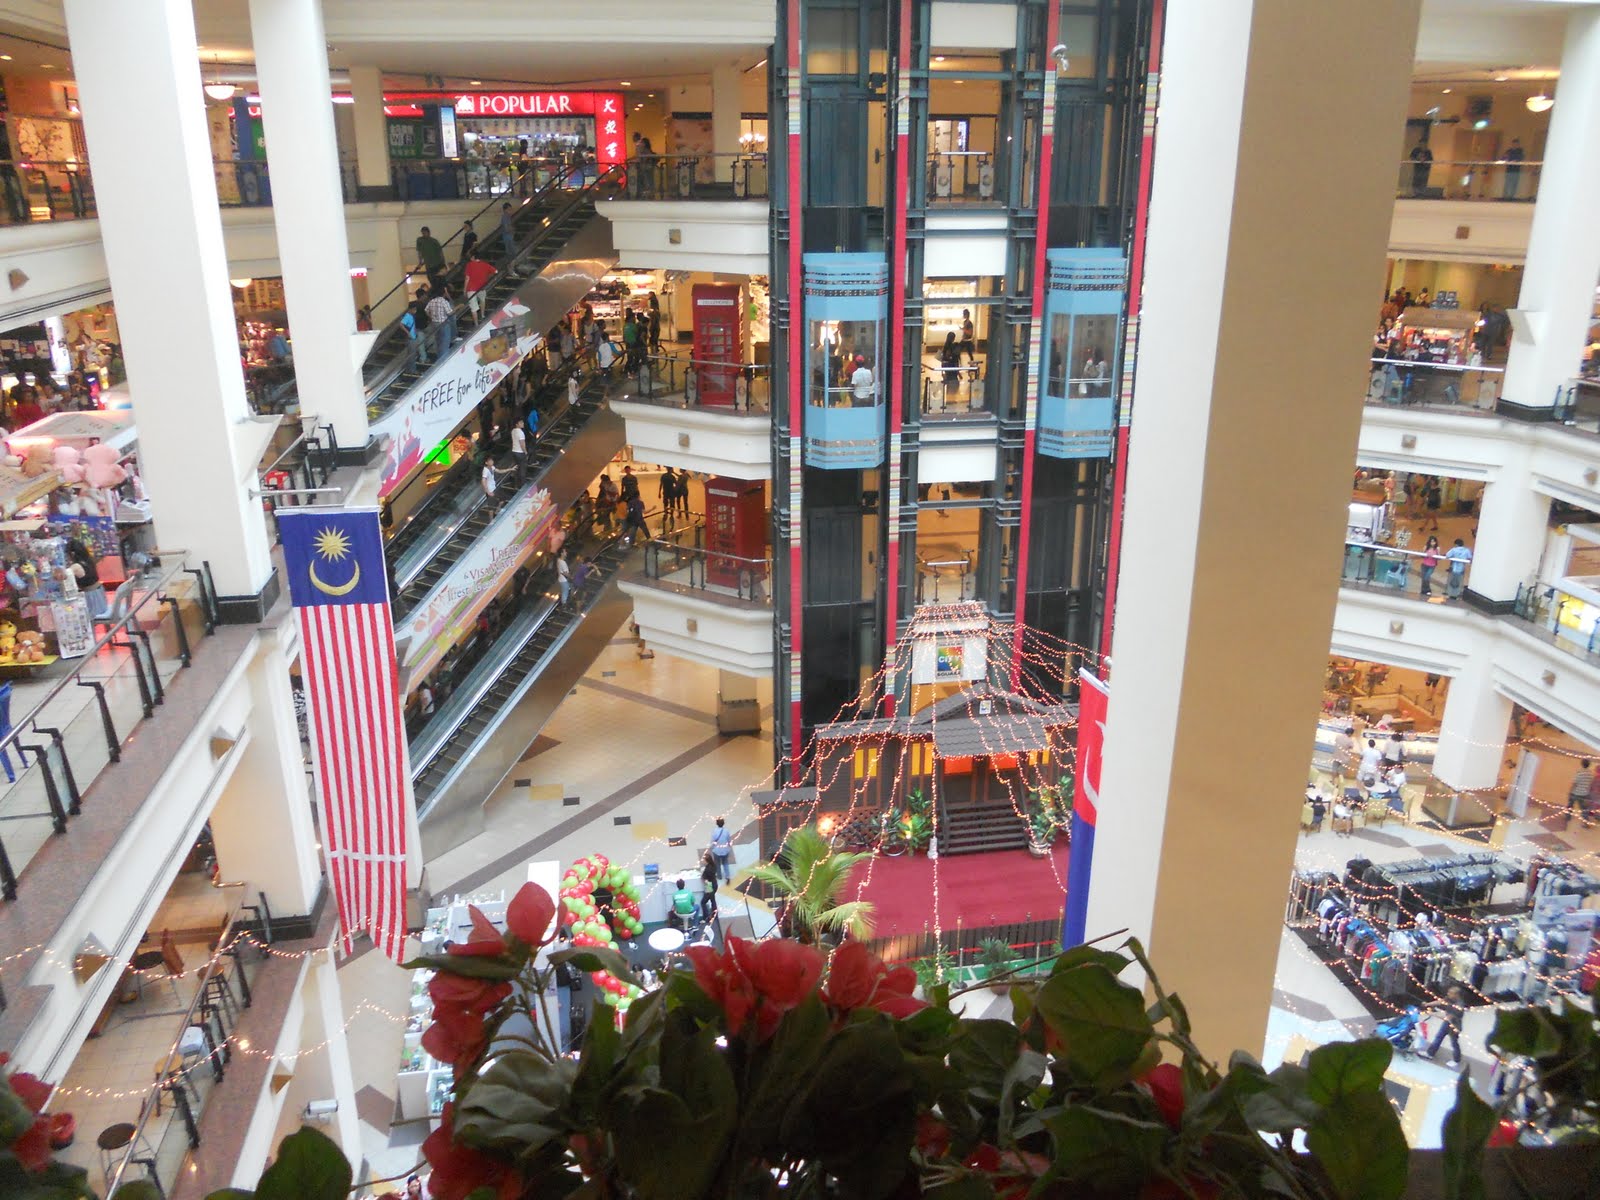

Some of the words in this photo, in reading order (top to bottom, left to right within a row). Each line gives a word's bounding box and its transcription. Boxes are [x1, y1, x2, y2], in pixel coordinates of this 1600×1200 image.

[479, 95, 573, 114] POPULAR
[423, 380, 455, 413] FREE
[456, 378, 470, 405] for
[474, 366, 492, 395] life
